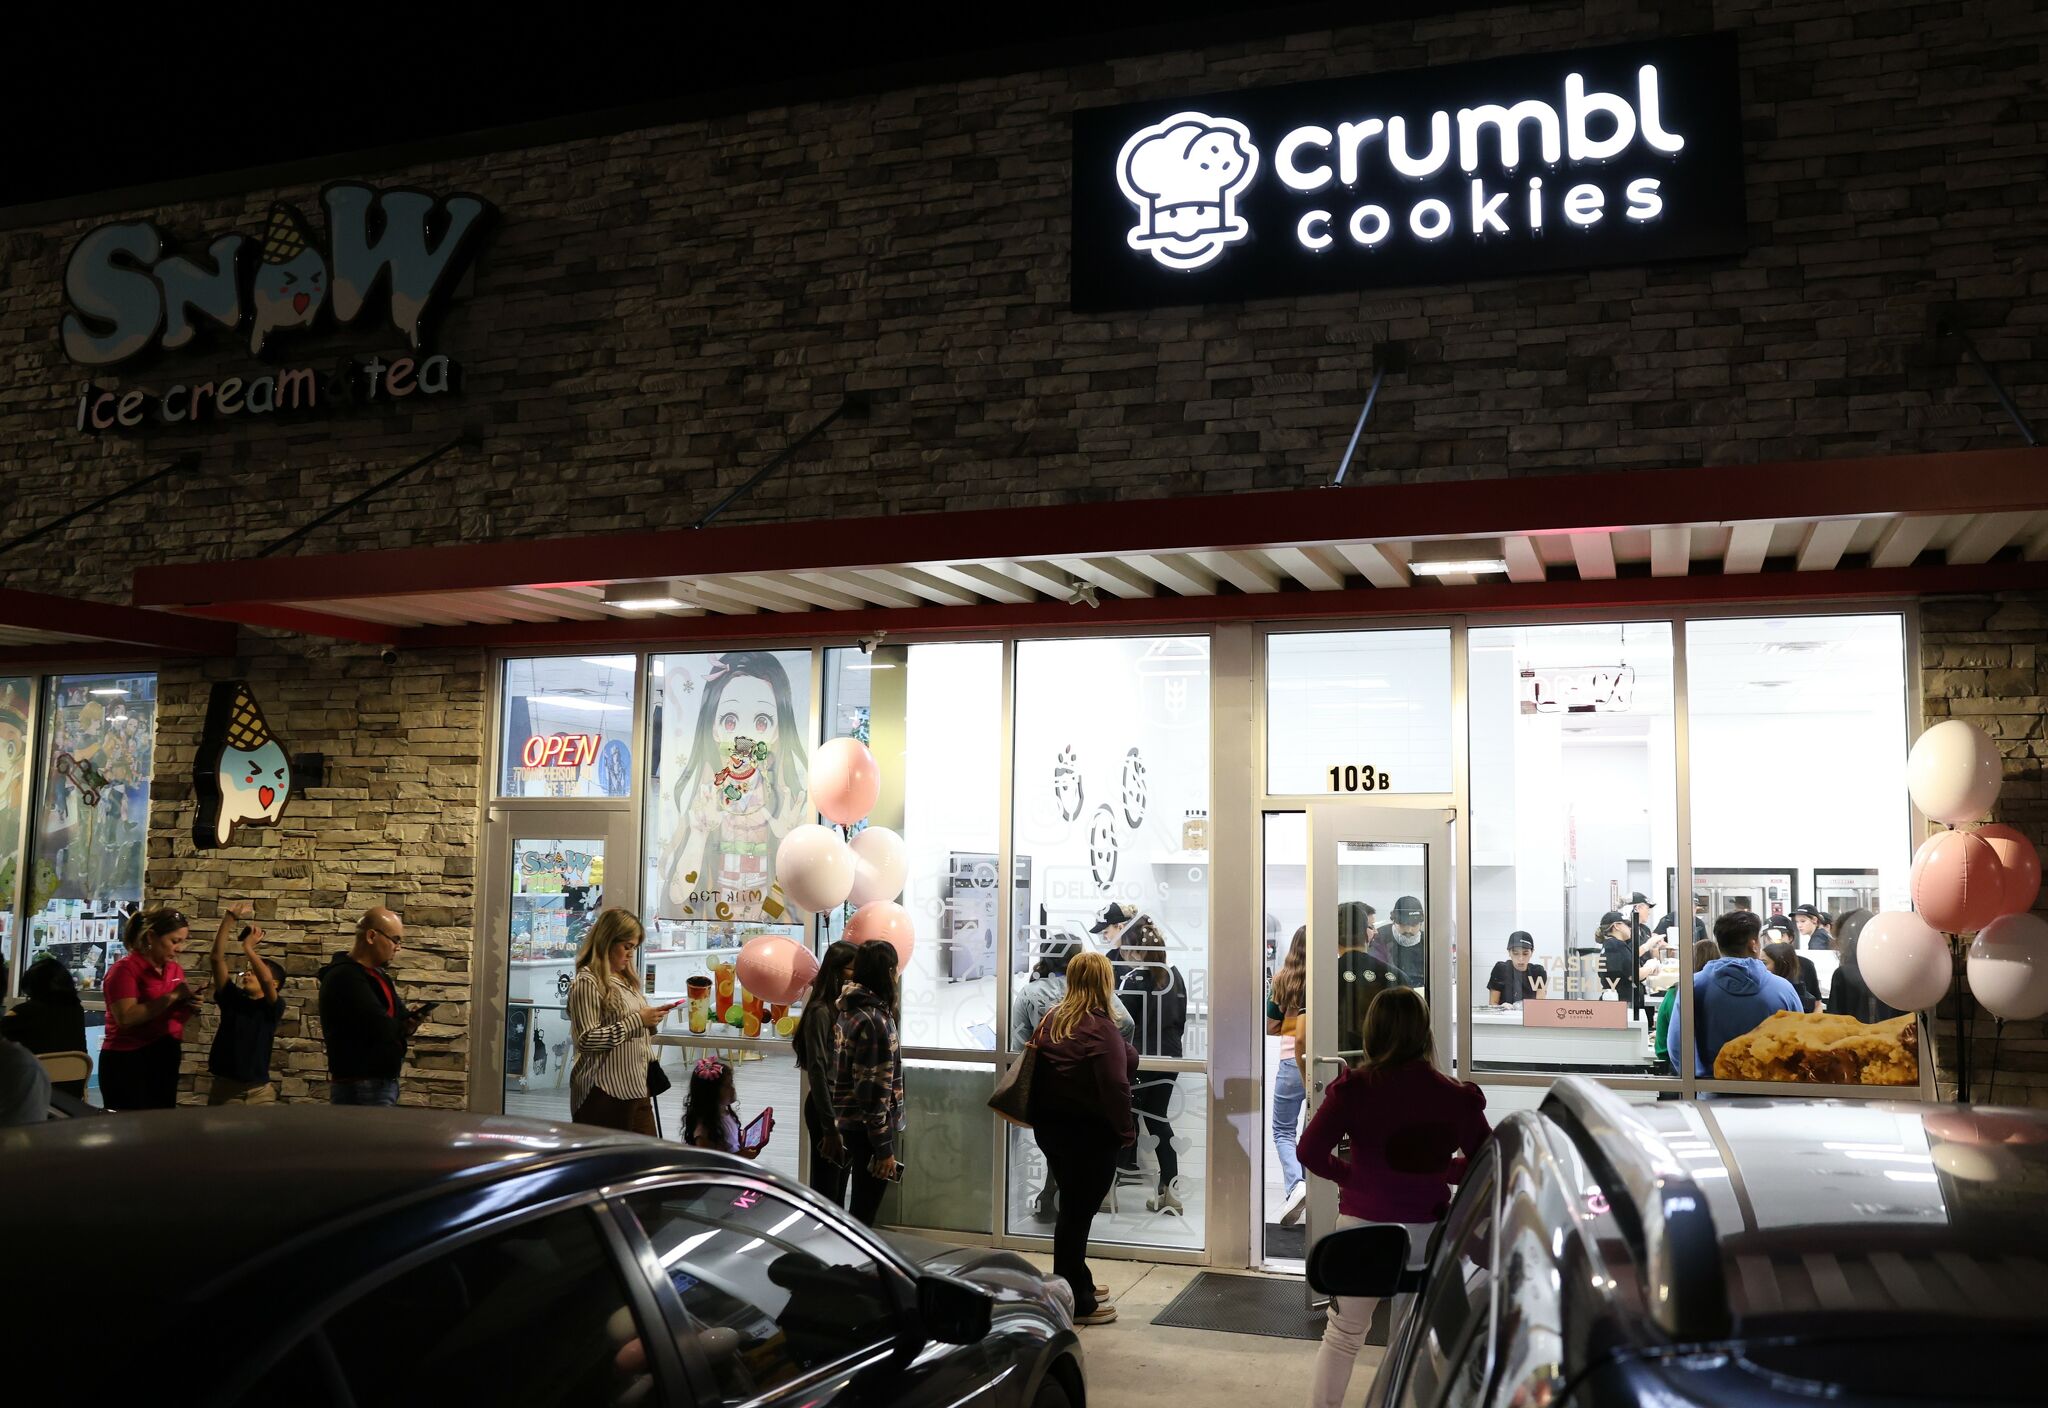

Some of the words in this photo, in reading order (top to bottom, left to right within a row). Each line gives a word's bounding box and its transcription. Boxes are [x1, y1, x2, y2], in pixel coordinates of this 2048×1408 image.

[1274, 64, 1685, 191] crumbl
[1297, 176, 1664, 250] cookies
[77, 382, 144, 432] ice
[162, 367, 317, 422] cream
[362, 354, 449, 399] tea
[522, 733, 602, 767] OPEN
[1527, 975, 1621, 993] WEEKLY
[1539, 955, 1608, 973] TASTE
[1567, 1008, 1594, 1016] crumbl
[1022, 1137, 1043, 1214] EVERY
